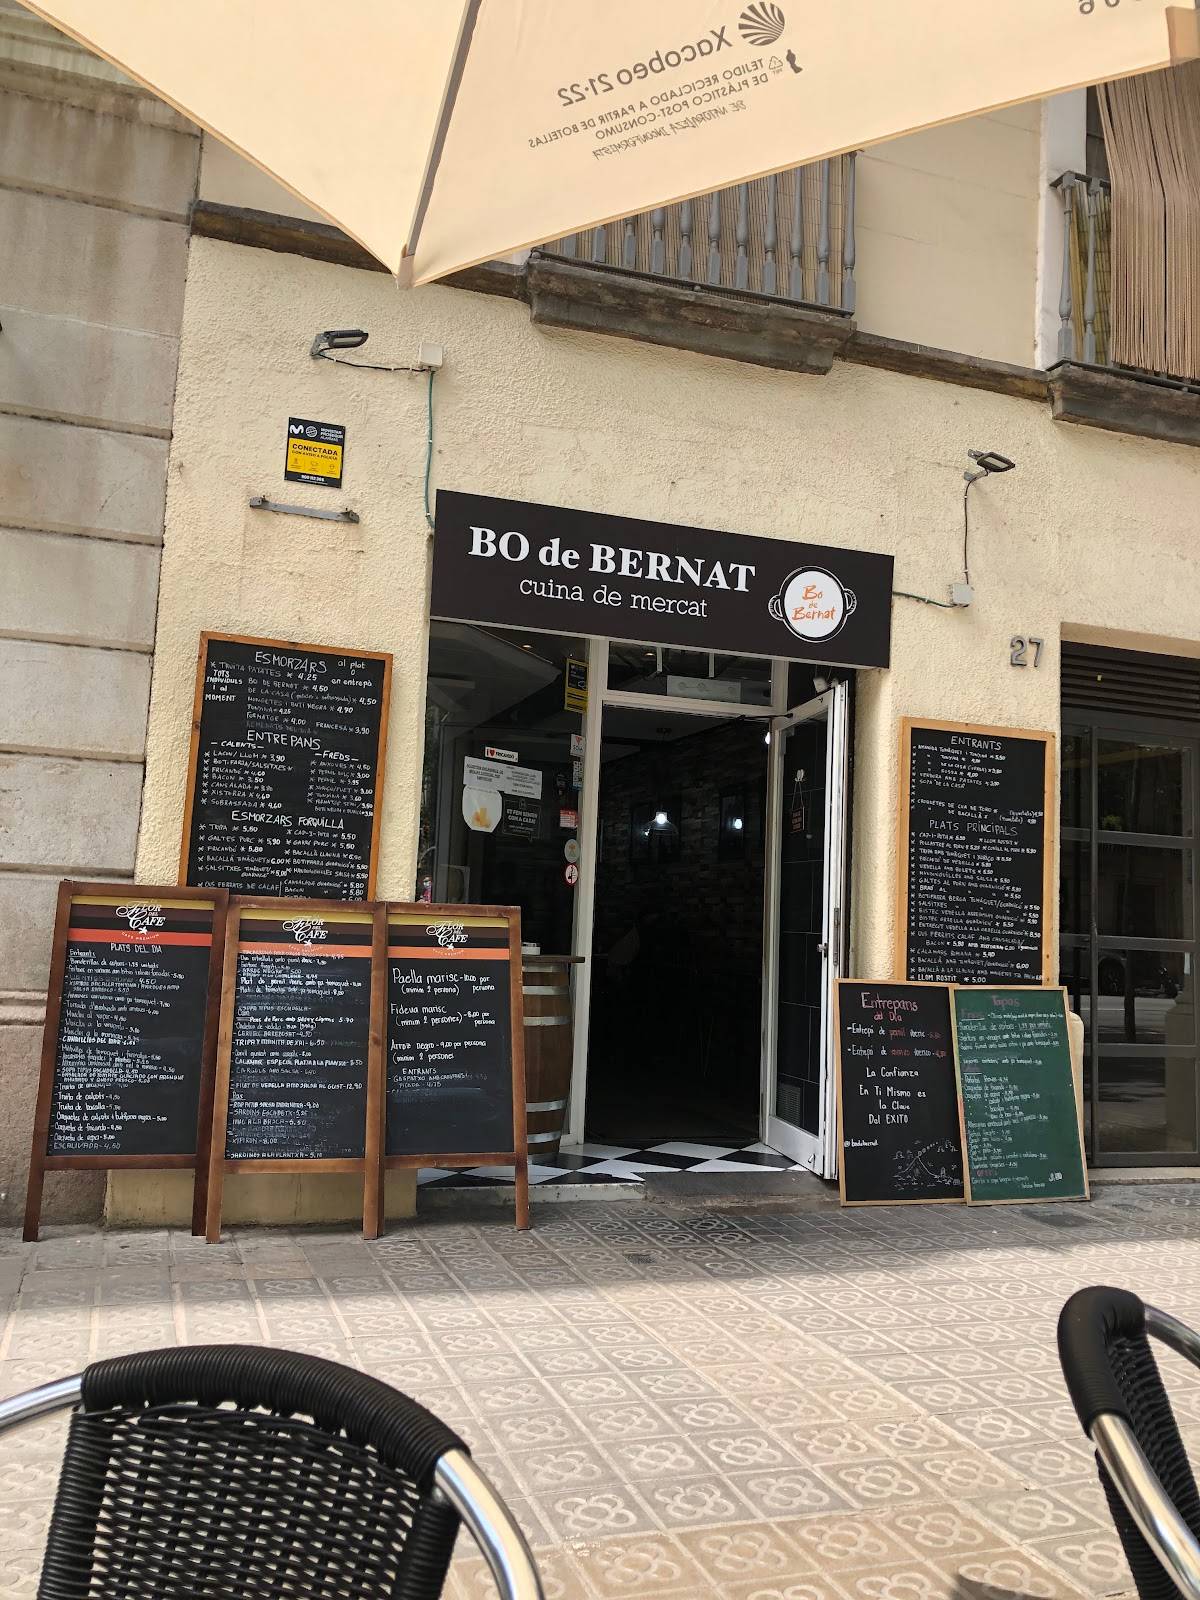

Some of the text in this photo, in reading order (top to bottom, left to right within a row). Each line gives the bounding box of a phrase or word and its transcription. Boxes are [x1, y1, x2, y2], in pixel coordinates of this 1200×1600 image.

[292, 443, 338, 456] CONECTADA
[468, 526, 756, 592] BO de BERNAT
[519, 579, 708, 617] cuina de mercat
[802, 585, 823, 600] Bo
[792, 607, 836, 620] Bernat
[1010, 635, 1044, 668] 27
[255, 651, 327, 673] ESMORZARS
[213, 669, 230, 678] TOTS
[205, 693, 236, 702] MOMENT
[247, 730, 321, 750] ENTRE PANS
[951, 735, 1002, 750] ENTRANTS
[322, 750, 350, 761] FREDS
[211, 773, 235, 781] BACON
[211, 782, 251, 790] CANSALADA
[231, 810, 292, 827] ESMORZARS
[929, 820, 960, 830] PLATS
[110, 942, 131, 952] PLATS
[135, 944, 150, 953] DEL
[392, 968, 422, 983] Paella
[426, 972, 459, 984] marisc
[422, 1005, 447, 1013] marisc
[861, 992, 919, 1015] Entrepans
[402, 1067, 437, 1075] ENTRANTS
[866, 1066, 919, 1077] La Confianza
[859, 1084, 869, 1095] En
[874, 1085, 882, 1096] Ti
[886, 1086, 911, 1097] Mismo
[879, 1098, 910, 1110] la Clave
[885, 1113, 909, 1125] EXITO
